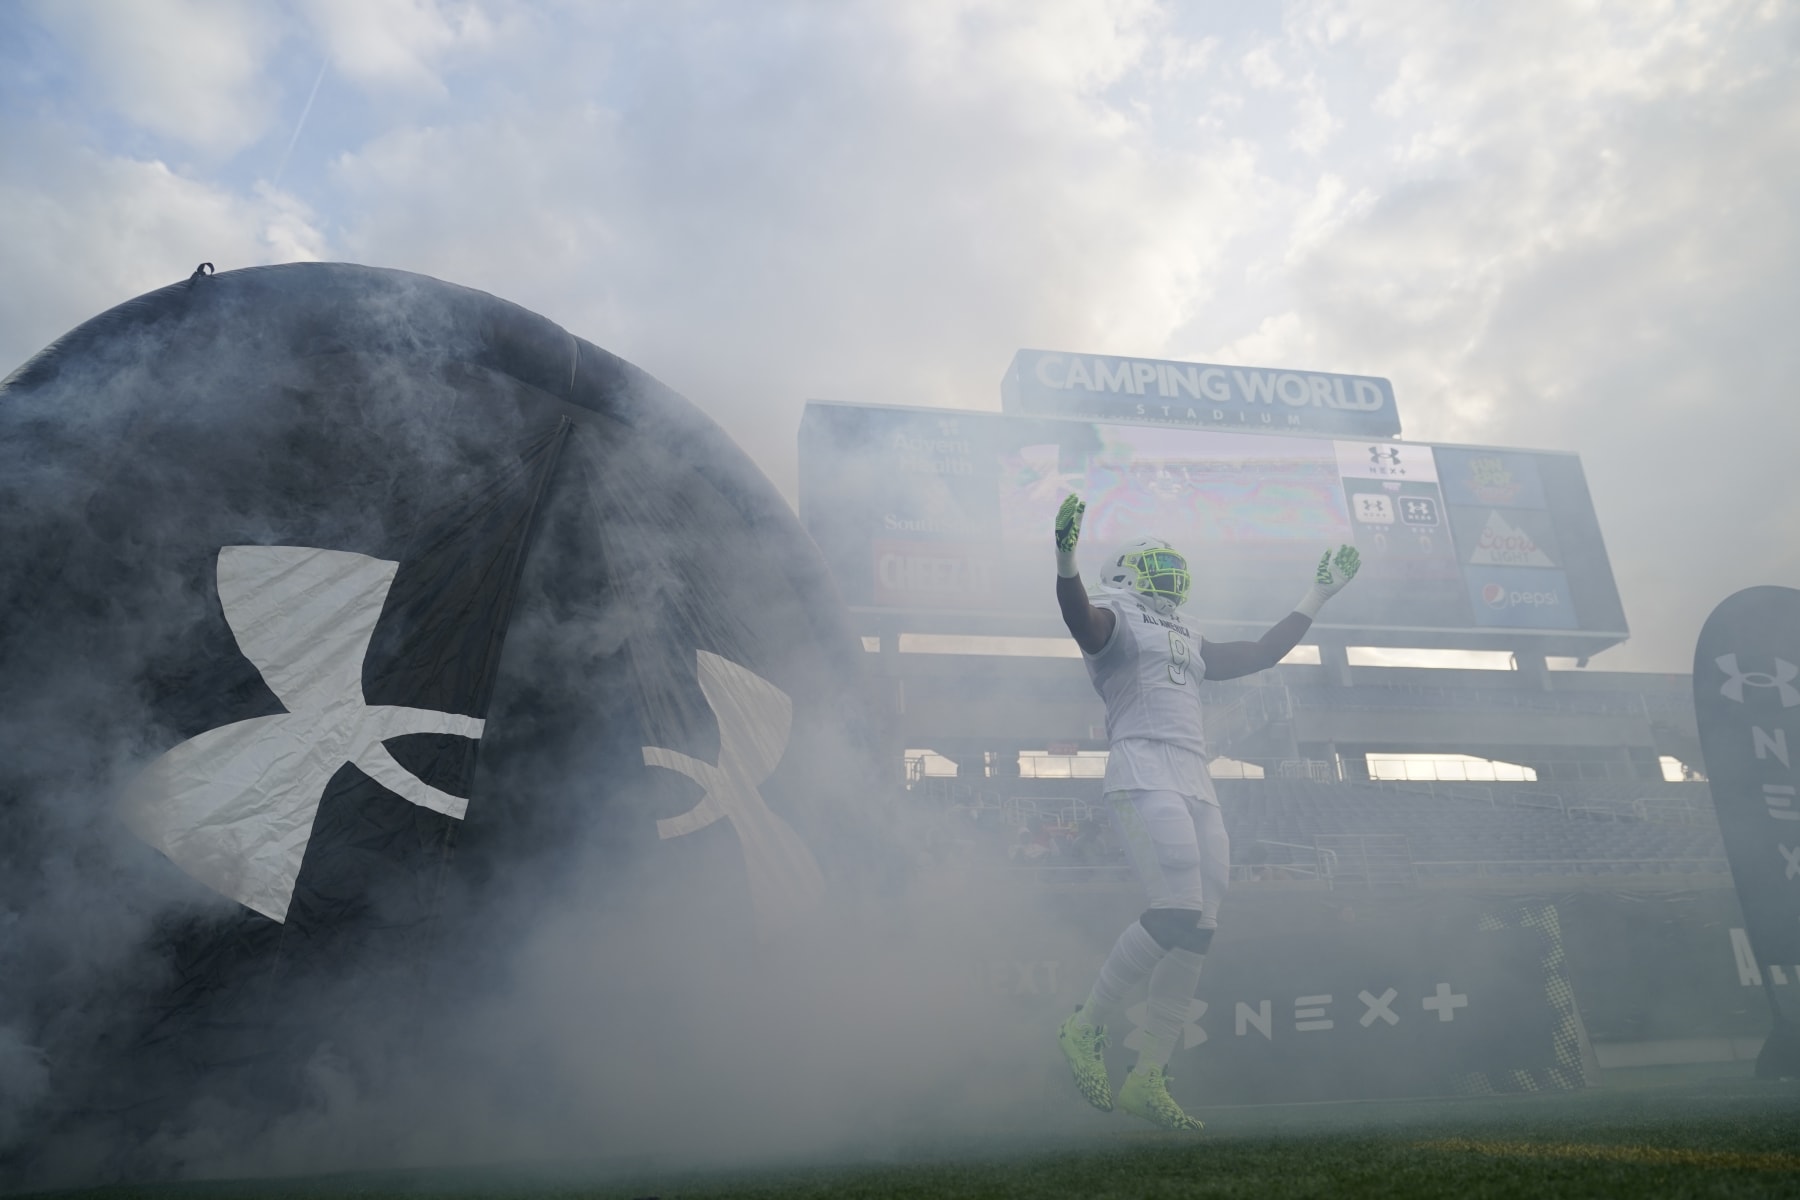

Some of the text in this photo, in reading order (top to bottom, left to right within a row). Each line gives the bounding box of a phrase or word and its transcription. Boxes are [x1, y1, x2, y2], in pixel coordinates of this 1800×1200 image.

[1035, 355, 1384, 412] CAMPING WORLD
[1135, 403, 1301, 426] STADIUM
[892, 432, 970, 455] Advent
[1479, 528, 1537, 553] Coors
[1490, 551, 1530, 564] LIGHT
[1510, 588, 1560, 608] pepsi
[1142, 612, 1159, 626] ALL
[1167, 630, 1191, 686] 9
